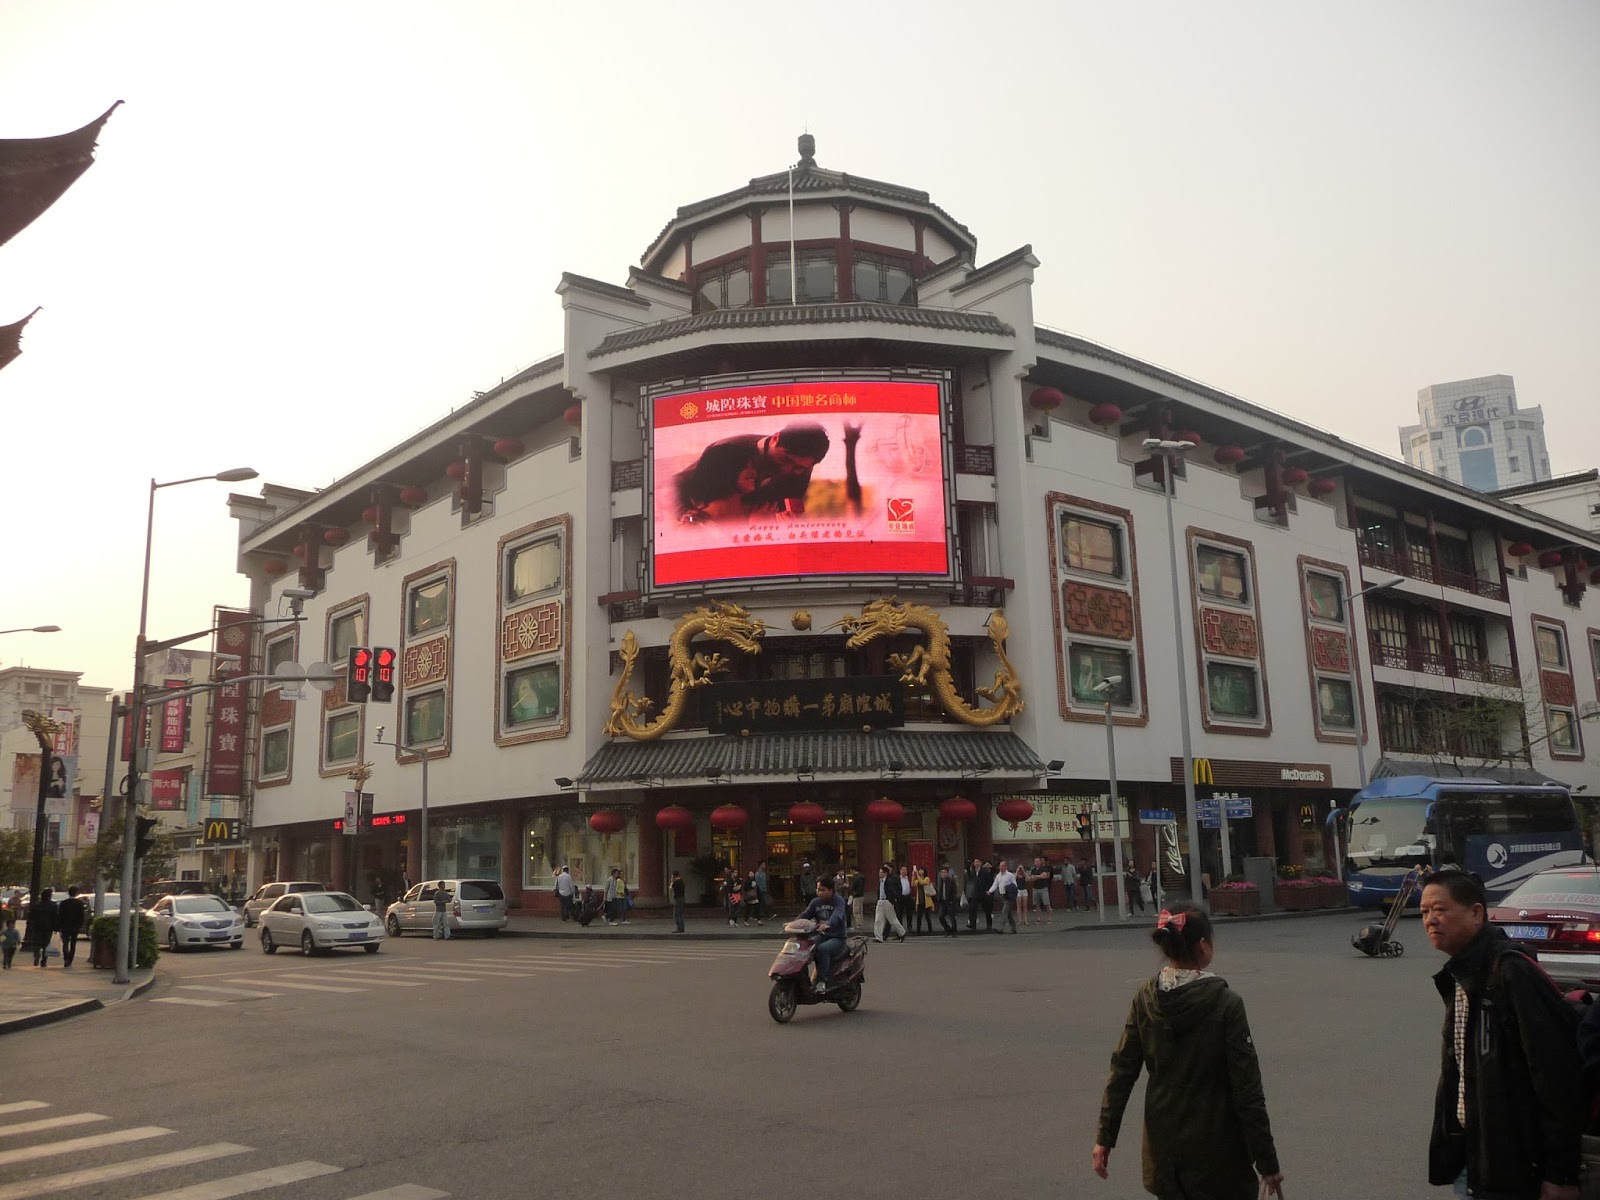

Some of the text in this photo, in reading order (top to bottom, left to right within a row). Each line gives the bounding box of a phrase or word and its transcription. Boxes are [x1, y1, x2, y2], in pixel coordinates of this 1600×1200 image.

[772, 393, 857, 408] 中国驰名商标
[1443, 407, 1500, 425] 北京现代
[355, 668, 366, 682] 10
[379, 667, 390, 682] 10
[167, 740, 178, 748] 2F
[1280, 768, 1325, 782] McDonald's
[1049, 804, 1059, 815] 2F
[1062, 804, 1077, 815] 白玉
[1025, 821, 1043, 833] 沉香
